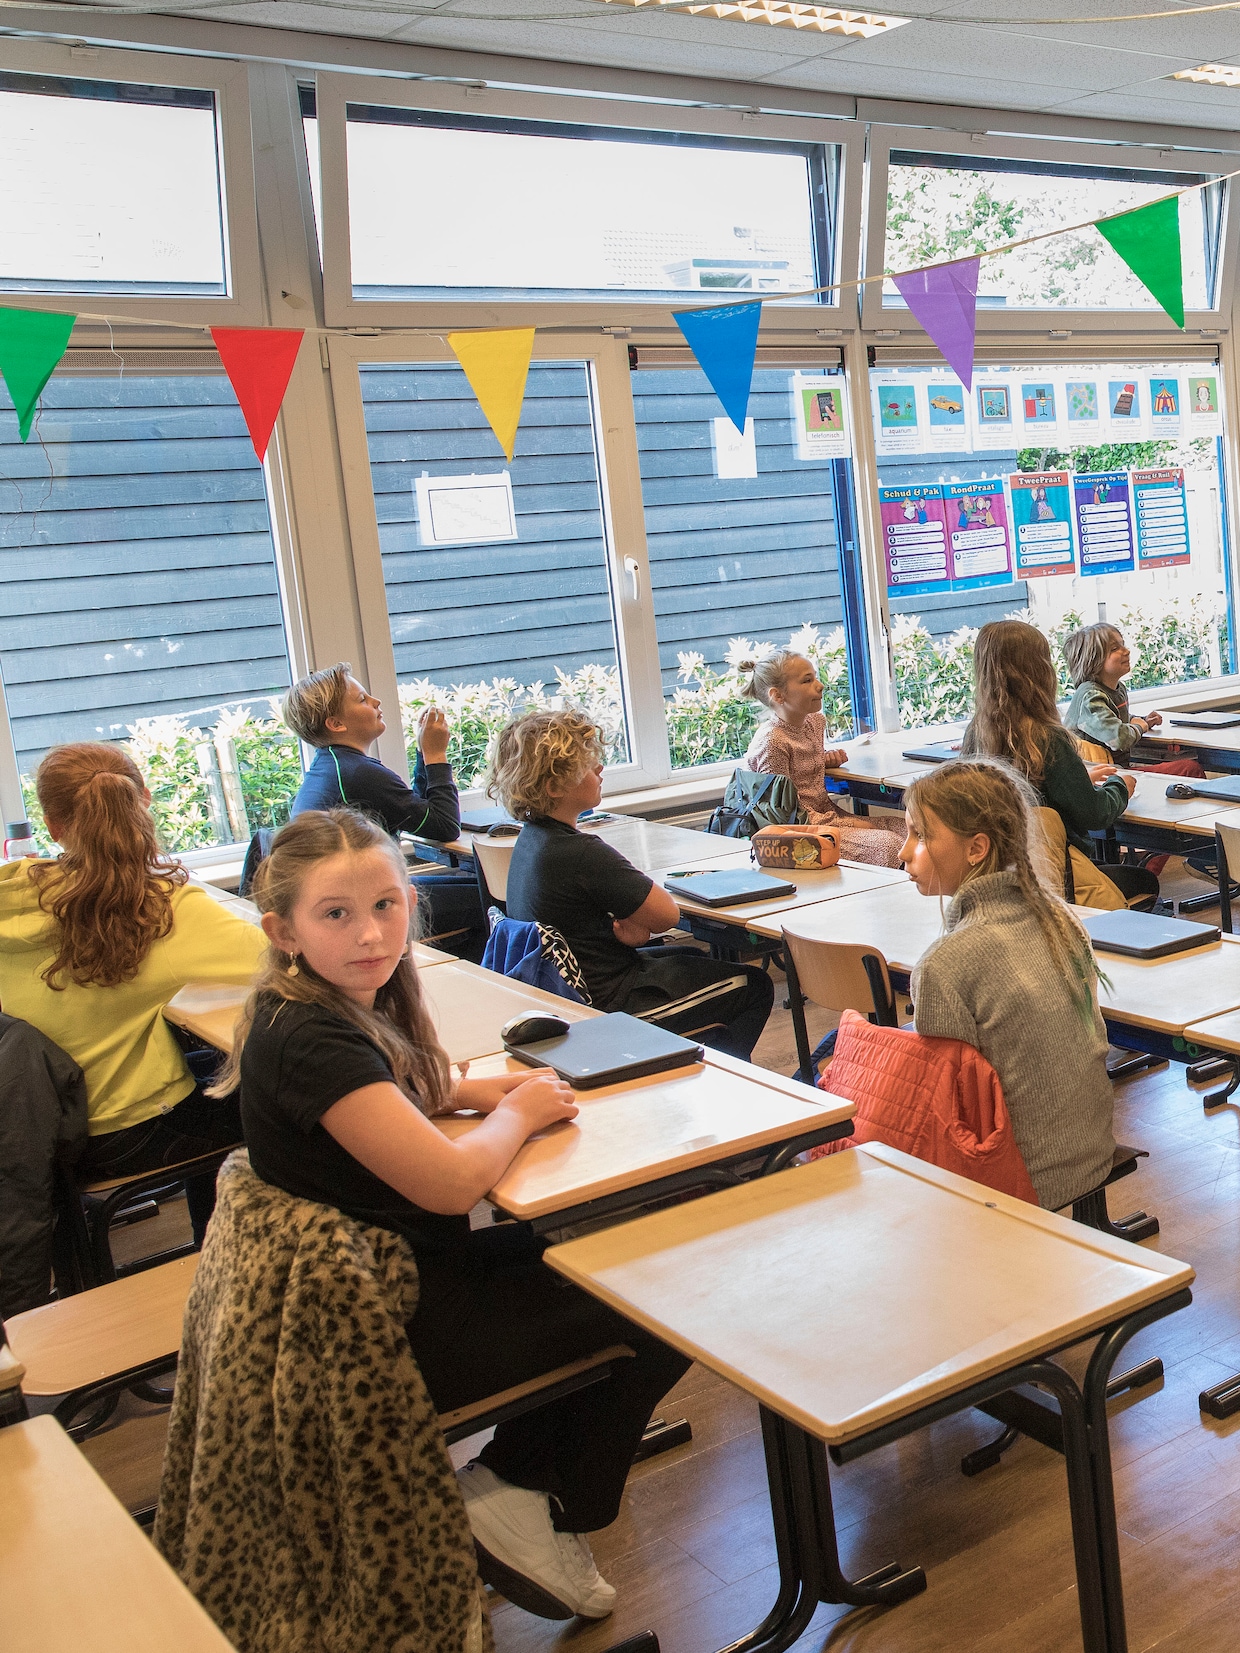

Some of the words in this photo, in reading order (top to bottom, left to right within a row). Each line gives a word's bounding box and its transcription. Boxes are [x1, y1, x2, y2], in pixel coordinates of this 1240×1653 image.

[1018, 476, 1062, 485] TweePraat
[1074, 476, 1109, 484] TweeGesprek
[1134, 473, 1151, 481] Vraag
[884, 490, 911, 498] Schud
[914, 488, 921, 496] &
[923, 487, 940, 495] Pak
[950, 483, 995, 495] RondPraat
[755, 839, 771, 847] STEP
[758, 845, 789, 858] YOUR
